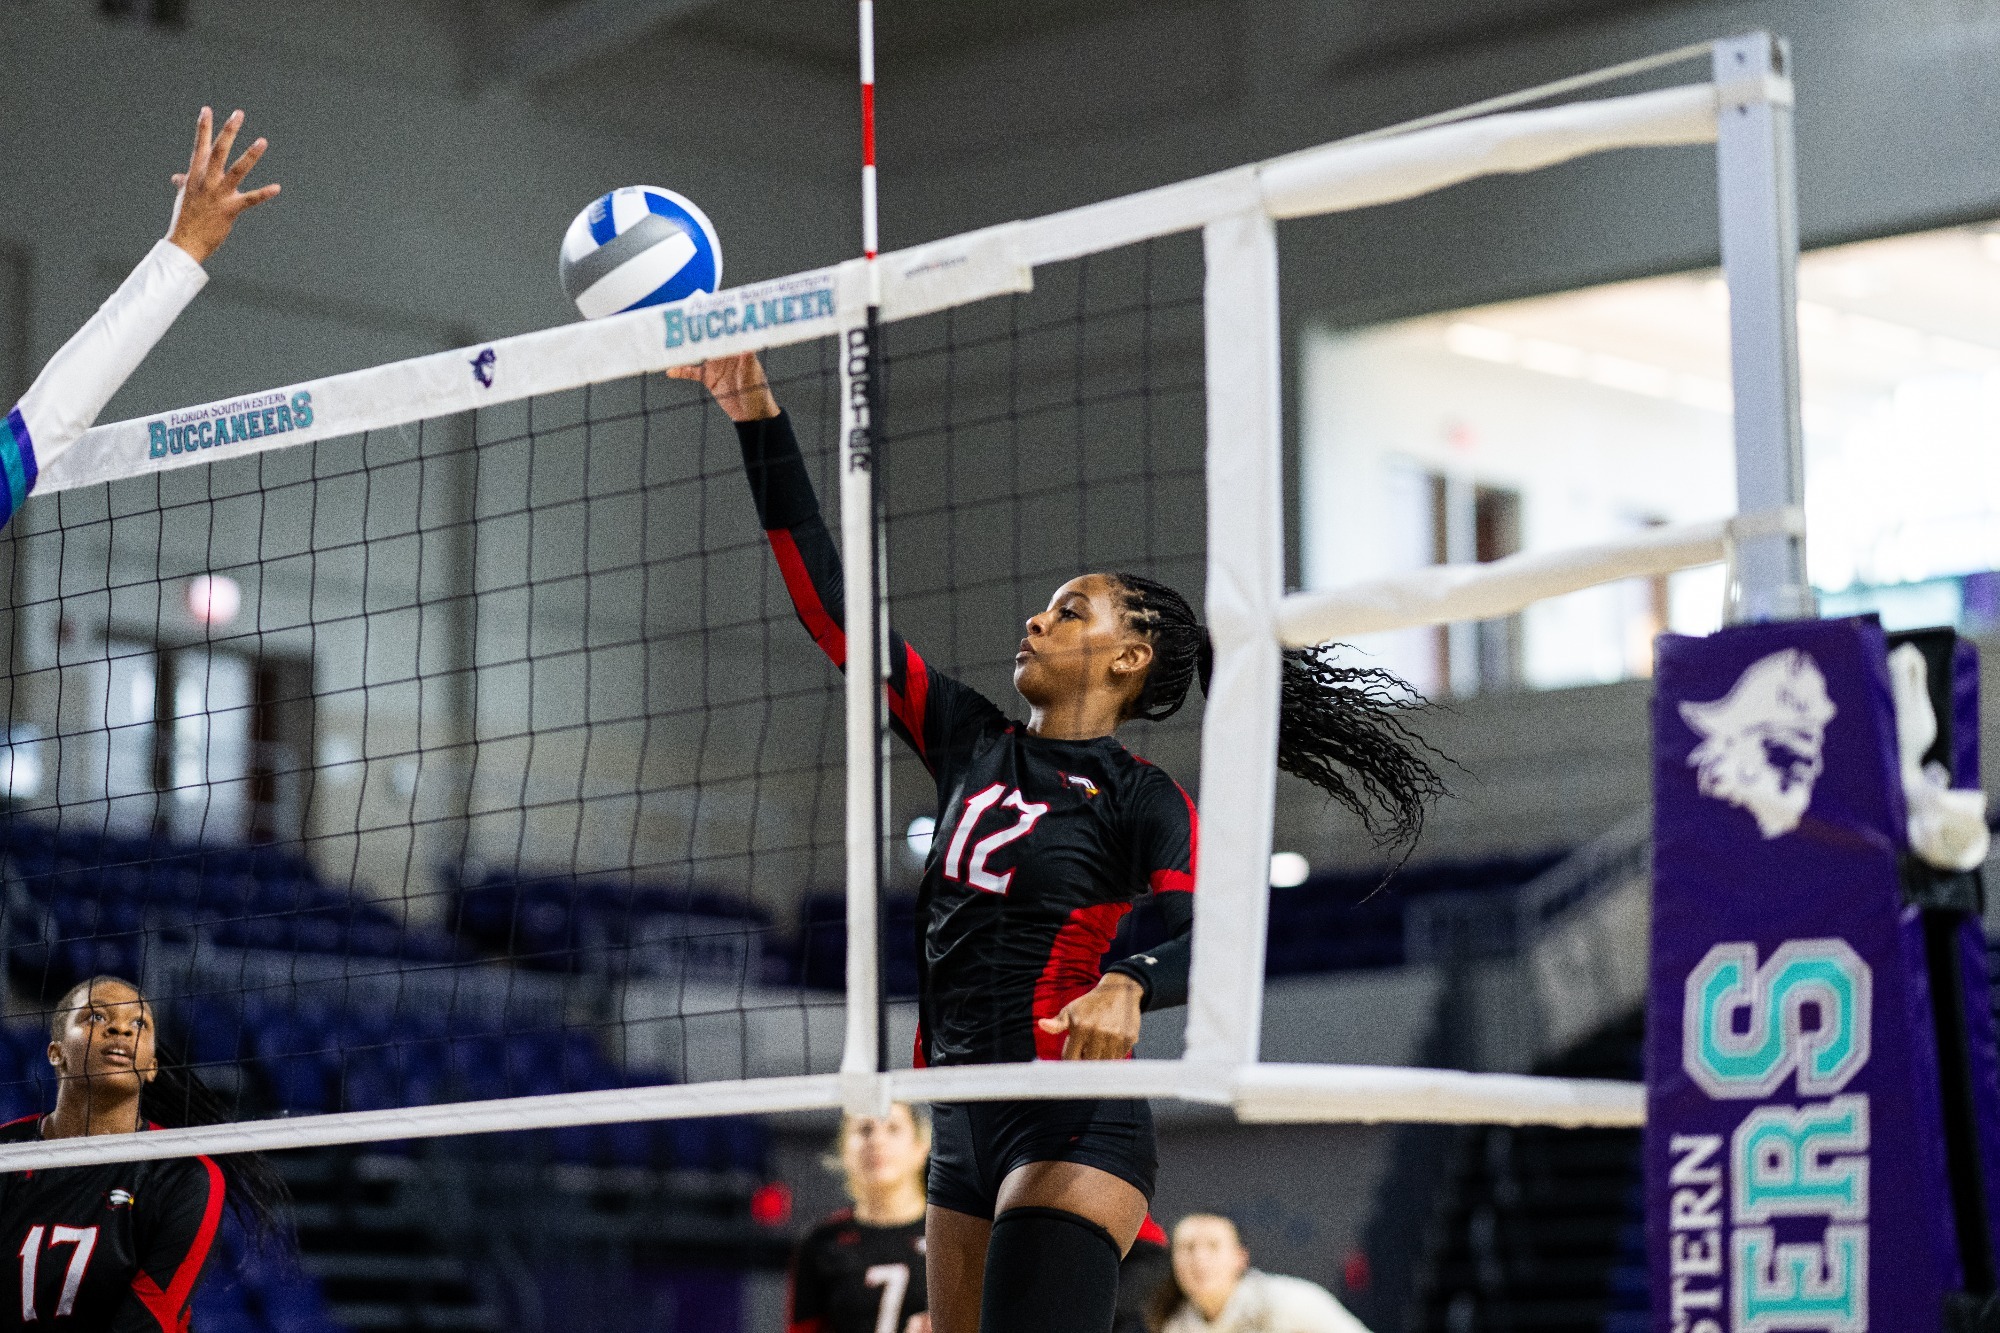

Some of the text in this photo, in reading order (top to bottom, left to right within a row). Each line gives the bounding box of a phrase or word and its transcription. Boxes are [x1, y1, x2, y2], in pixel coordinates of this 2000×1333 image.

[147, 389, 315, 460] BUCCANEERS
[170, 409, 209, 427] FLORIDA
[943, 781, 1050, 897] 12
[1682, 937, 1874, 1333] ERS
[17, 1223, 100, 1323] 17
[863, 1261, 911, 1333] 7
